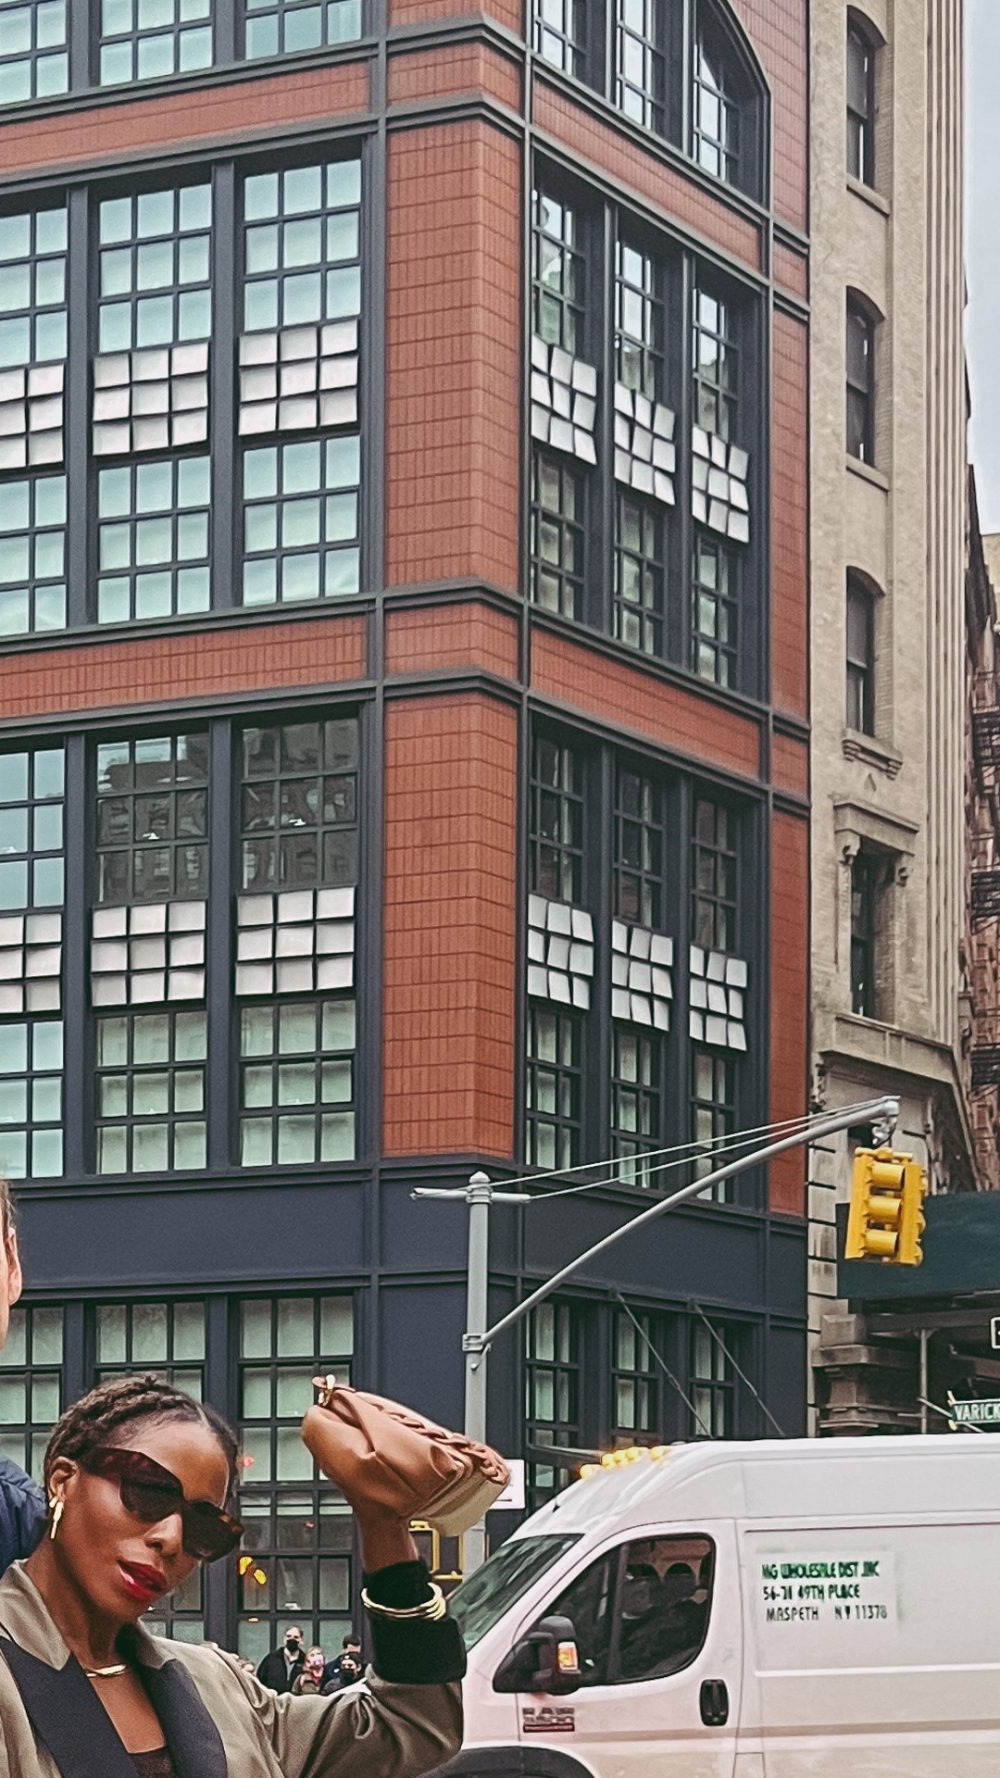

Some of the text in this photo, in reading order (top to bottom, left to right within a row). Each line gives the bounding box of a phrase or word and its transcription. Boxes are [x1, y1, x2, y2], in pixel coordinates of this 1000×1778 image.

[954, 1403, 1000, 1421] VARICK
[828, 1583, 861, 1599] PLACE
[766, 1606, 820, 1622] MASPETH
